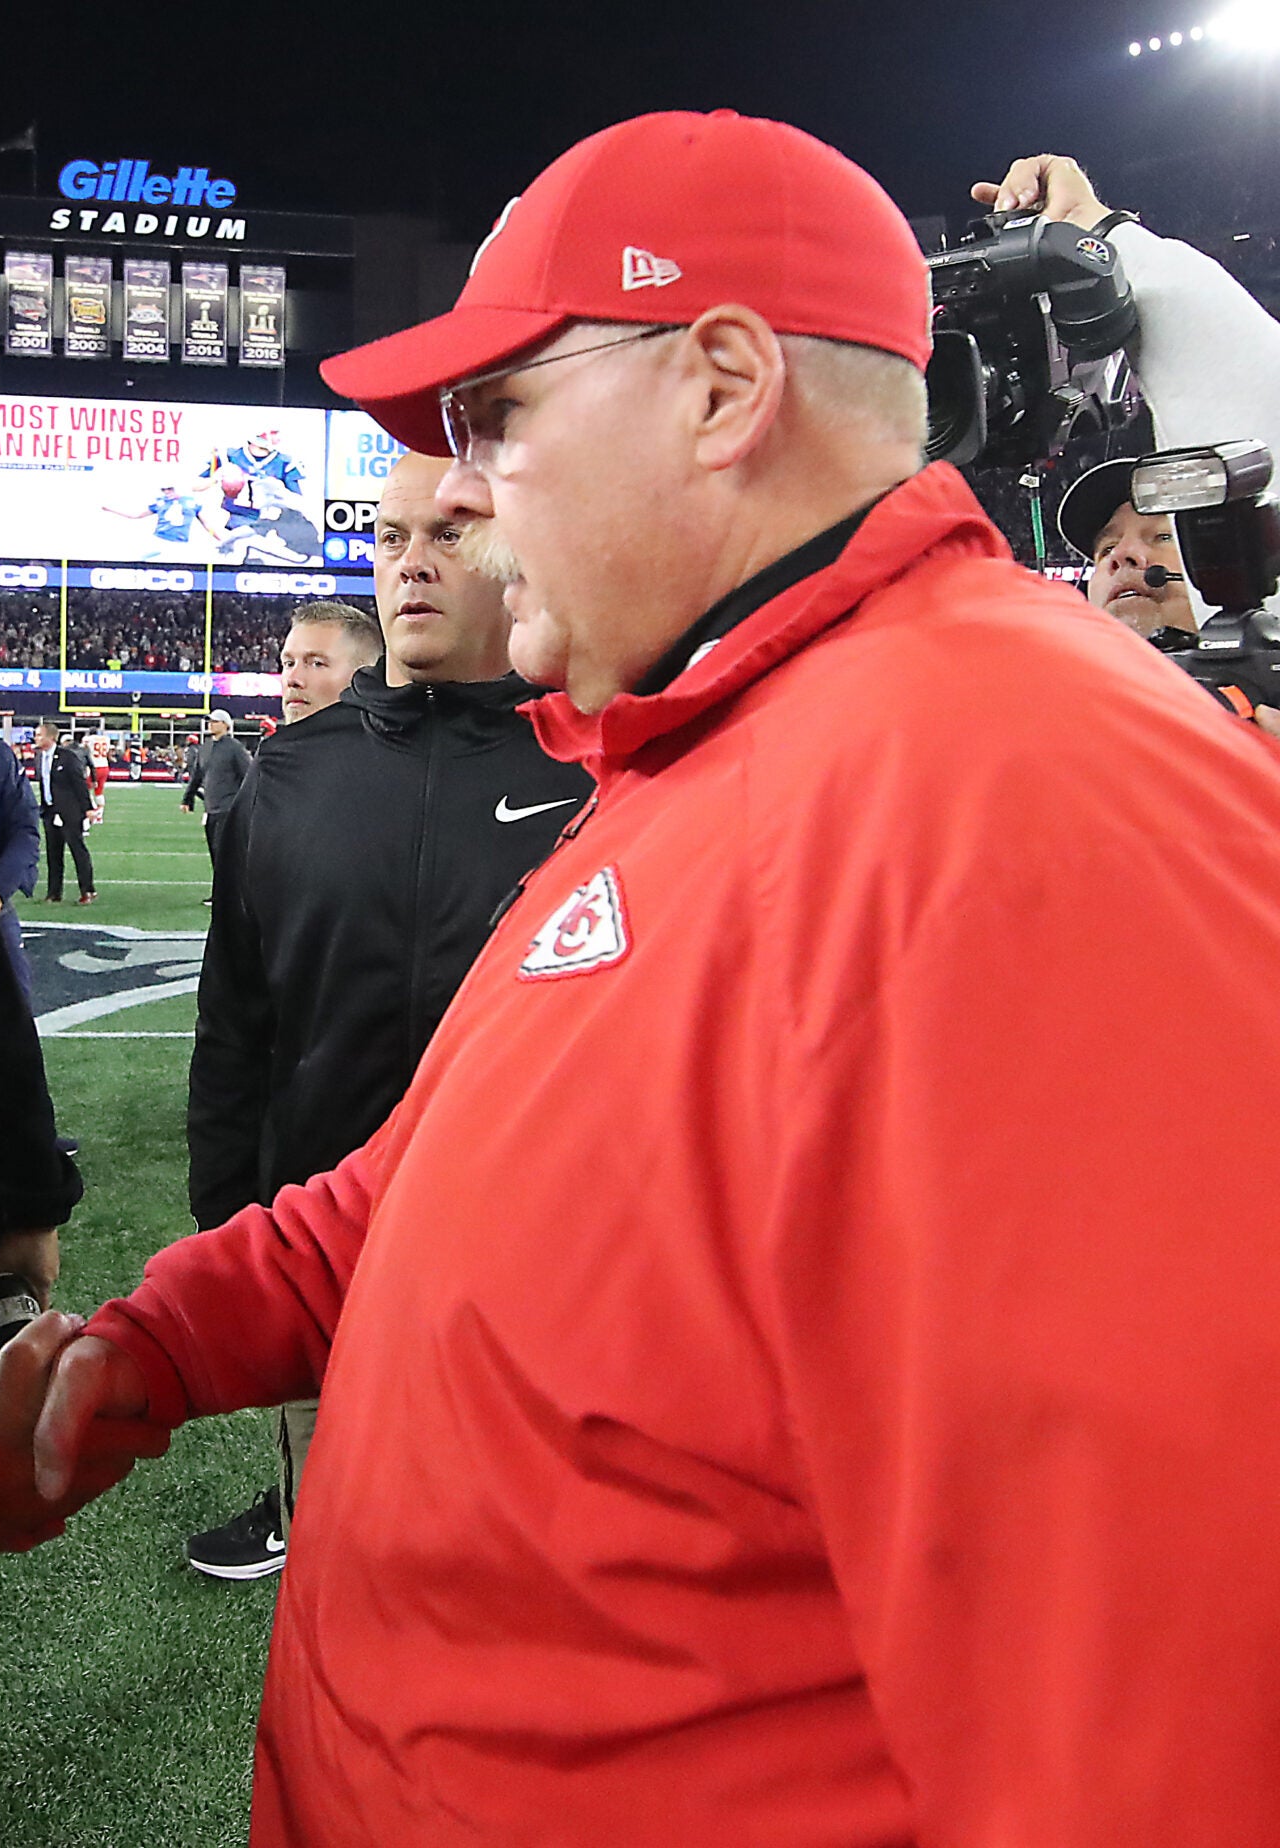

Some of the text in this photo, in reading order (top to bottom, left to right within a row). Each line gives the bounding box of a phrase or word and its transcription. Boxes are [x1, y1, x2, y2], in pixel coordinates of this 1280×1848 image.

[58, 158, 236, 209] Gillette
[49, 208, 246, 240] STADIUM
[11, 337, 46, 348] 2001
[69, 340, 106, 351] 2003
[127, 343, 165, 354] 2004
[187, 345, 221, 357] 2014
[245, 349, 279, 359] 2016
[70, 406, 143, 433] WINS
[152, 410, 183, 435] BY
[32, 434, 77, 459] NFL
[87, 436, 180, 462] PLAYER
[346, 456, 400, 478] LIG
[325, 501, 380, 532] OP
[89, 568, 194, 591] GEICO
[235, 572, 337, 595] GEICO
[26, 670, 42, 688] 4
[99, 673, 122, 689] ON
